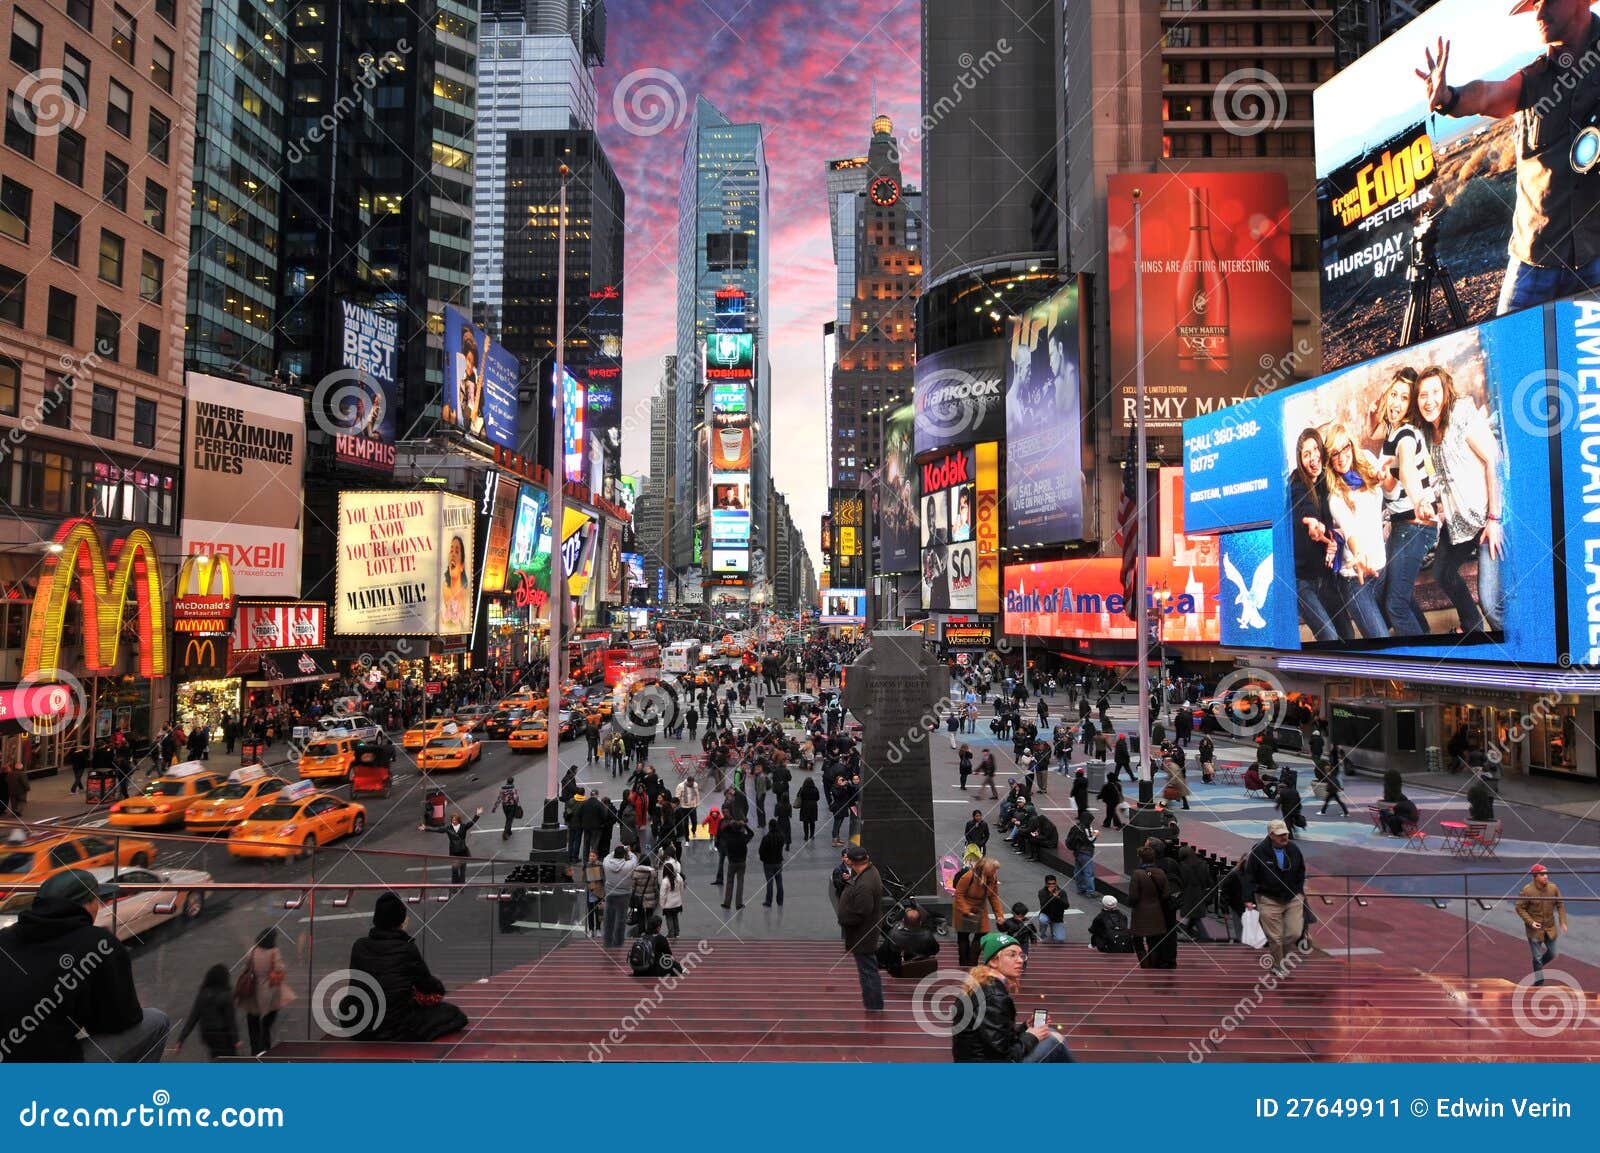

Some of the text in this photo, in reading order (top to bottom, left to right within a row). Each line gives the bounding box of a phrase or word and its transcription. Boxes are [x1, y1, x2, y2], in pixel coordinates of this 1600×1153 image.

[1356, 134, 1434, 218] Edge
[1134, 259, 1270, 273] HINGS ARE GETTING INTERESTING
[1325, 231, 1404, 282] THURSDAY
[342, 300, 398, 337] WINNER!
[343, 329, 395, 368] BEST
[343, 352, 395, 382] MUSICAL
[708, 368, 753, 378] TOSHIBA
[196, 401, 244, 423] WHERE
[196, 416, 293, 452] MAXIMUM
[336, 432, 395, 465] MEMPHIS
[194, 451, 243, 475] LIVES
[195, 436, 292, 465] PERFORMANCE
[924, 450, 969, 493] Kodak
[346, 500, 425, 526] YOU ALREADY
[369, 520, 405, 540] KNOW
[978, 489, 997, 571] Kodak
[189, 541, 285, 569] maxell
[346, 535, 433, 561] YOU'RE GONNA
[366, 555, 416, 577] LOVE IT!
[952, 548, 972, 578] SO
[175, 602, 230, 611] McDonald's
[347, 586, 396, 611] MAMMA
[398, 583, 427, 606] MIA!
[515, 570, 549, 619] Disney
[1007, 586, 1196, 615] Bank of Ameica
